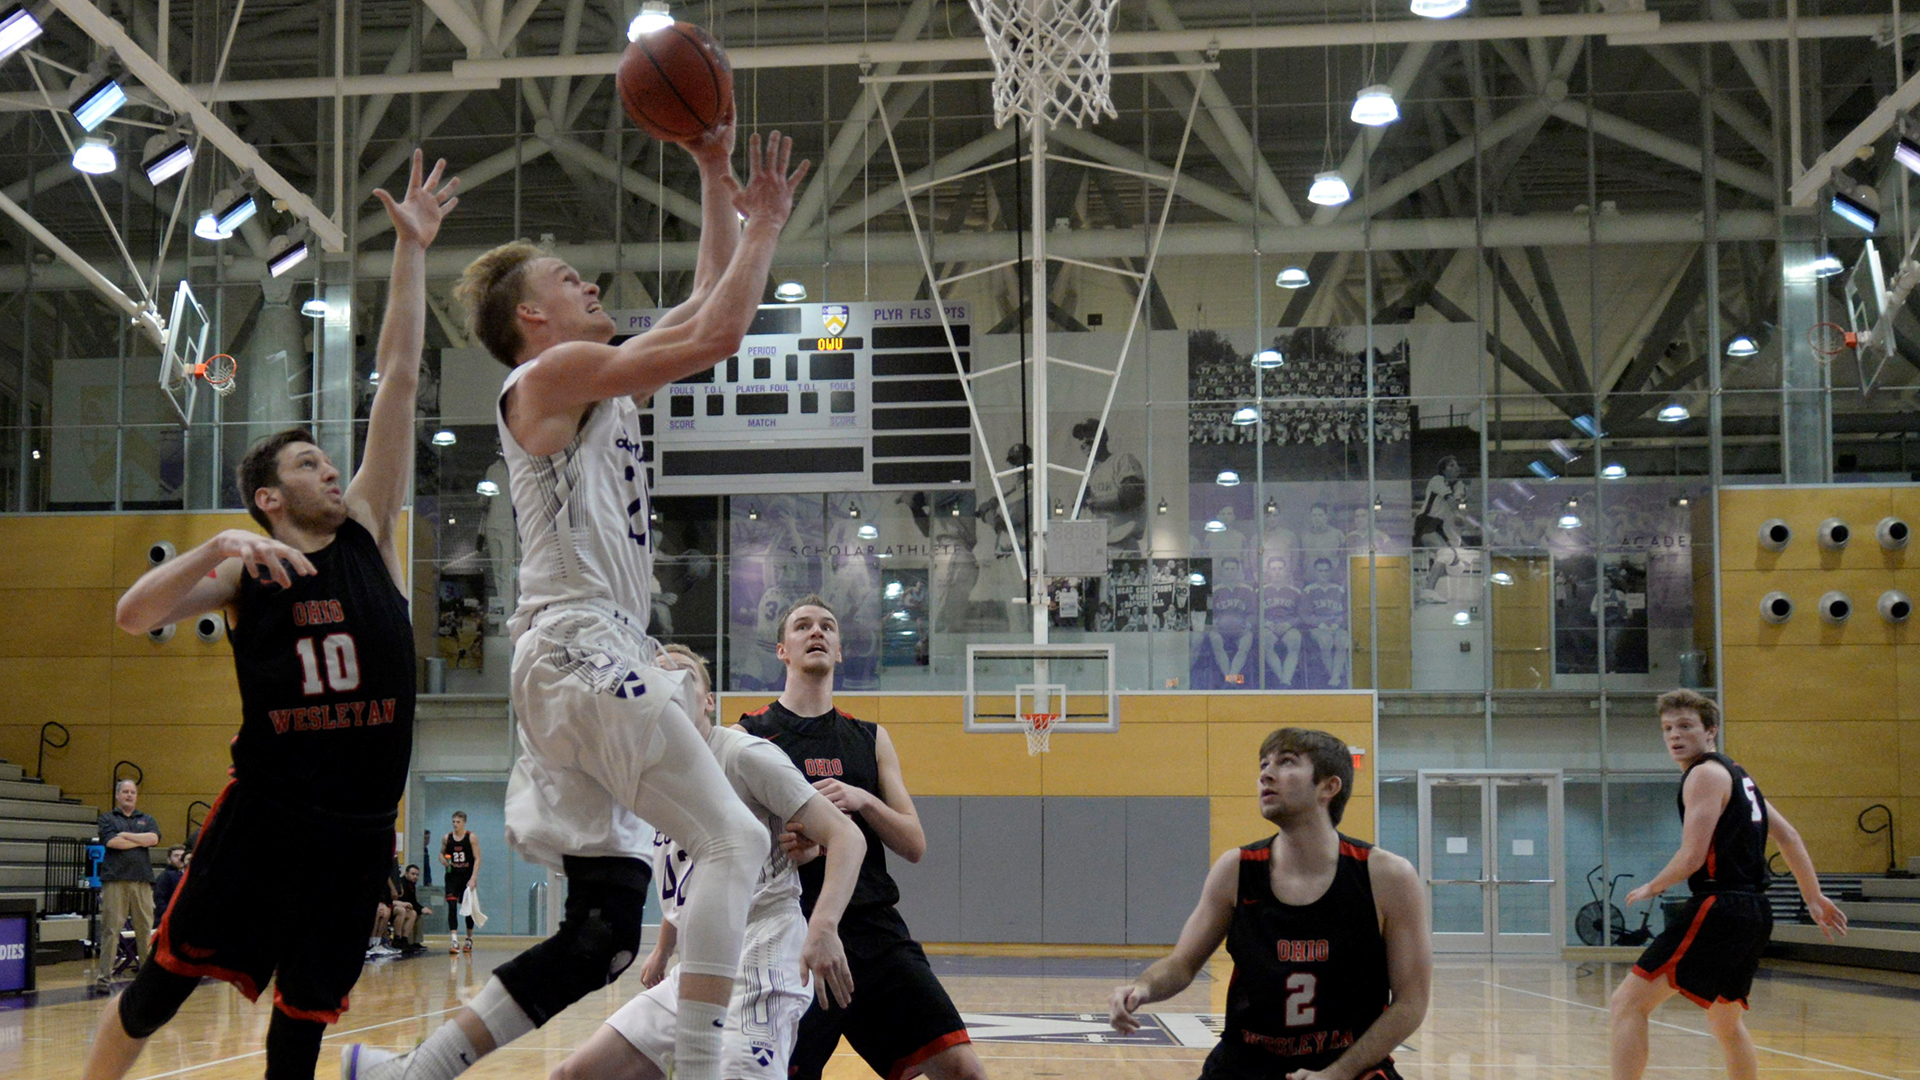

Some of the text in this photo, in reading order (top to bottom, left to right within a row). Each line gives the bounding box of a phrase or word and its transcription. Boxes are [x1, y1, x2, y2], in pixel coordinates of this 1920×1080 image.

[874, 307, 965, 320] PLYR FLS PTS
[630, 316, 651, 328] PTS
[747, 346, 777, 355] PERIOD
[817, 337, 844, 351] OWU
[670, 386, 695, 395] FOULS
[736, 384, 765, 393] PLAYER
[770, 384, 789, 393] FOUL
[830, 382, 855, 391] FOULS
[669, 416, 856, 429] SCORE MATCH SCORE
[1621, 536, 1687, 548] ACADE
[790, 544, 960, 557] SCHOLAR ATHLETE
[293, 600, 344, 626] OHIO
[296, 633, 361, 696] 10
[268, 698, 396, 735] WESLEYAN
[804, 758, 843, 776] OHIO
[453, 851, 466, 862] 23
[1277, 939, 1329, 962] OHIO
[1285, 972, 1317, 1027] 2
